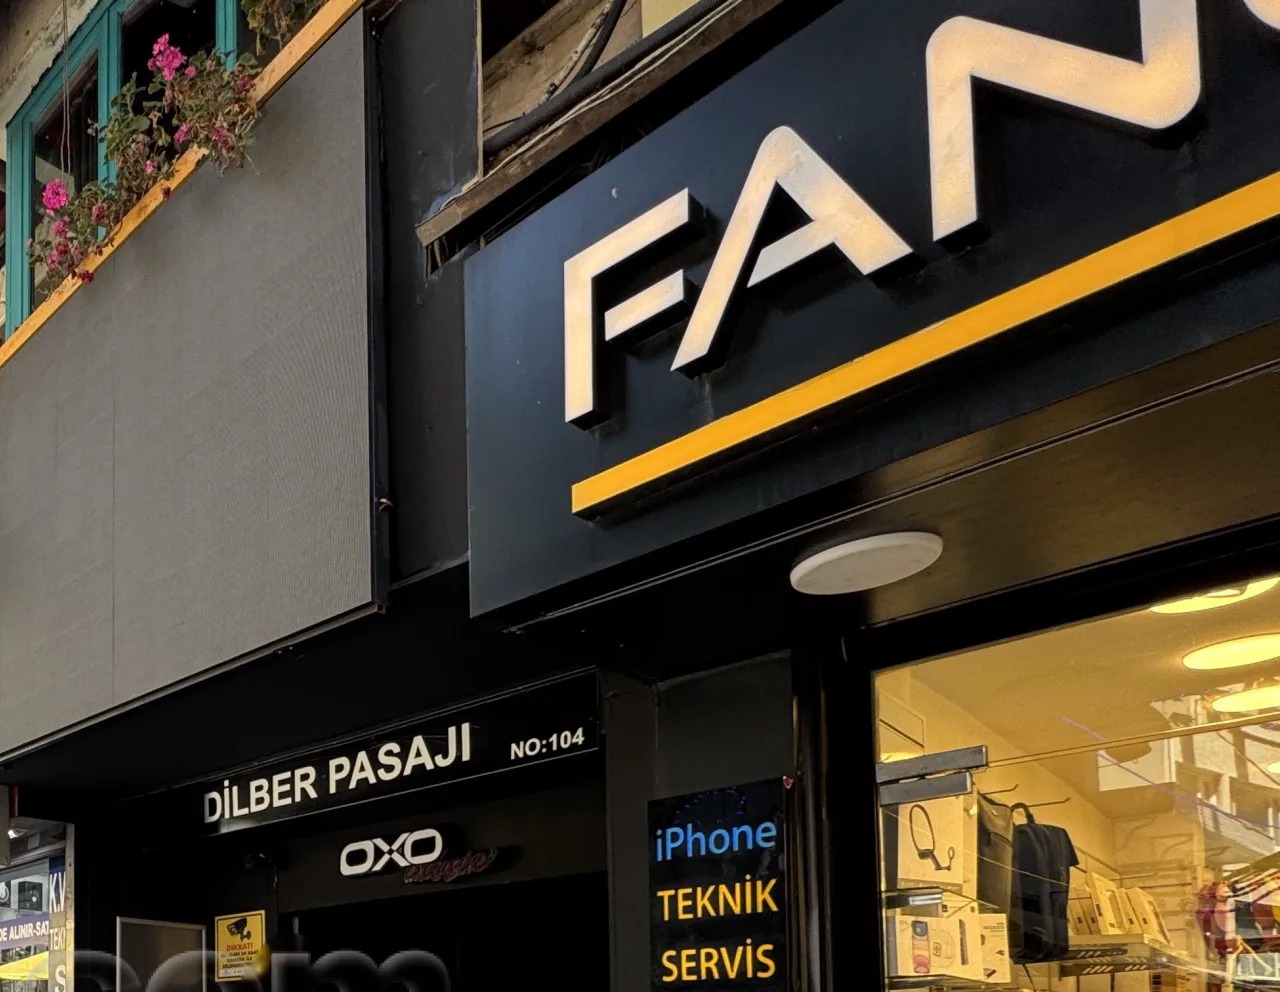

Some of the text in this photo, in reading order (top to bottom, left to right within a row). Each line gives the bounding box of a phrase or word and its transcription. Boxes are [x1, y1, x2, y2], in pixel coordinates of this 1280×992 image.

[564, 0, 1280, 424] FAN
[510, 727, 585, 760] NO:104
[204, 722, 471, 823] DİLBER PASAJI
[340, 828, 443, 876] OXO
[656, 822, 777, 862] iPhone
[656, 874, 779, 921] TEKNİK
[661, 938, 776, 982] SERVİS
